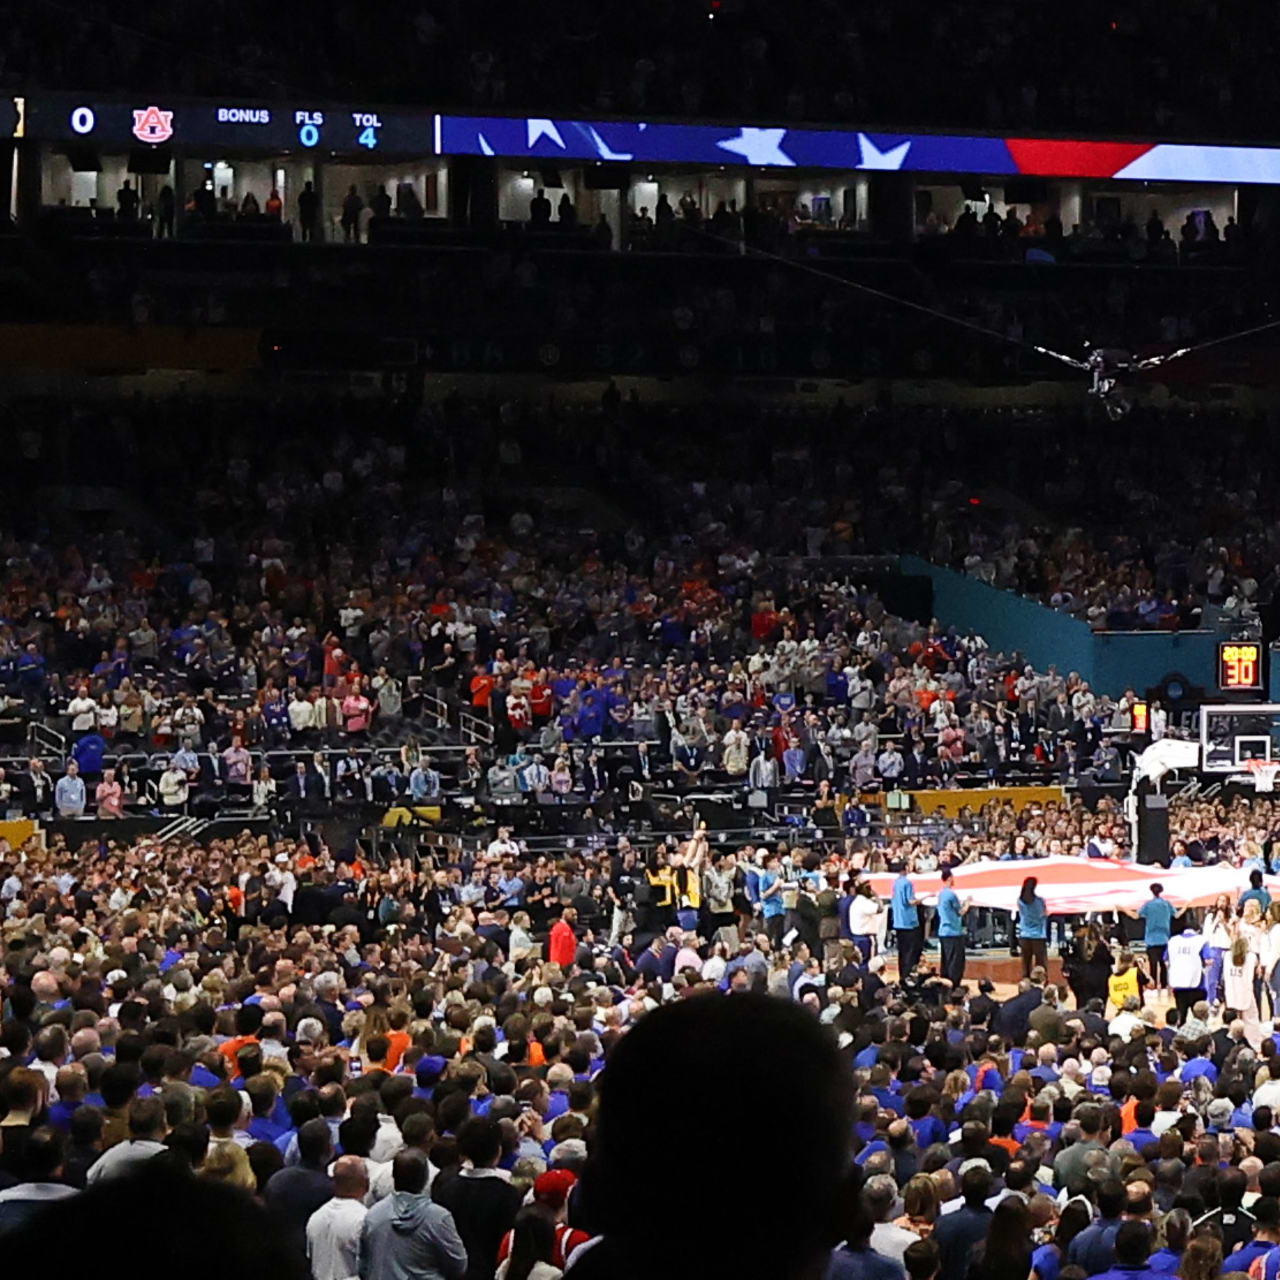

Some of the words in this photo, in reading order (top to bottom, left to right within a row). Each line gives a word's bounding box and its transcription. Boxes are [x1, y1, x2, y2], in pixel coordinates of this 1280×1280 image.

[71, 106, 95, 134] 0
[217, 108, 270, 124] BONUS
[295, 111, 324, 125] FLS
[353, 113, 382, 128] TOL
[300, 125, 319, 147] 0
[358, 126, 377, 149] 4
[1227, 662, 1253, 685] 30
